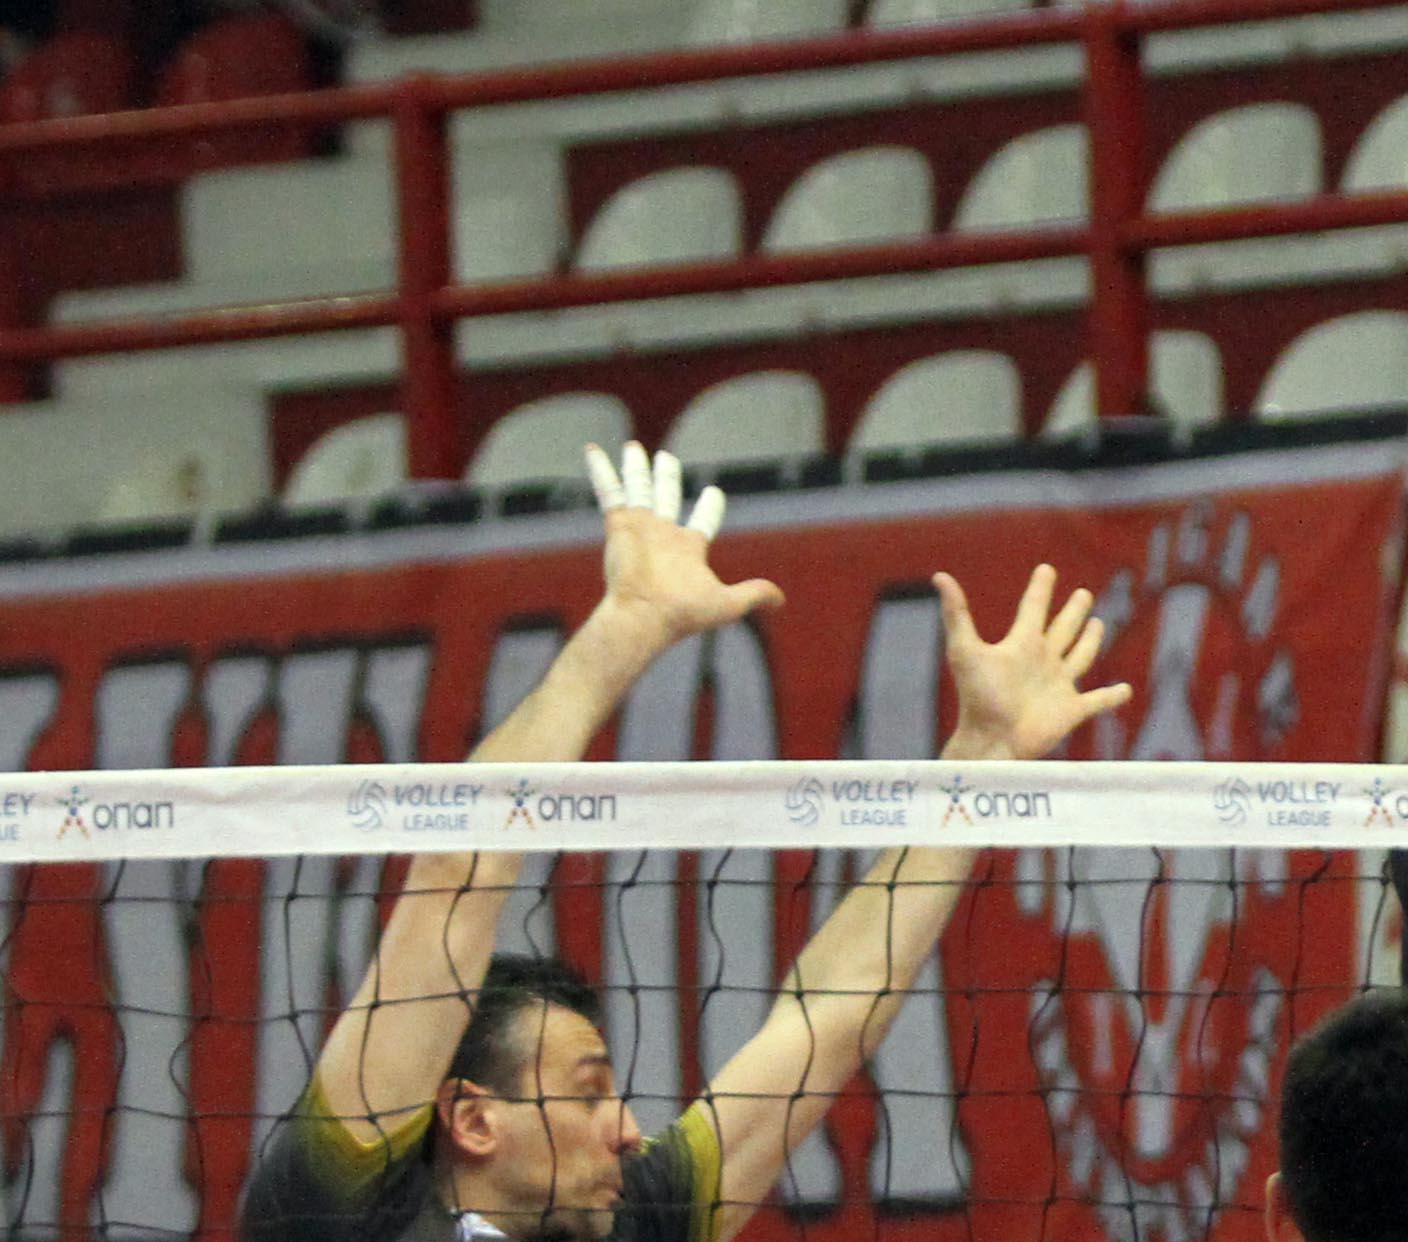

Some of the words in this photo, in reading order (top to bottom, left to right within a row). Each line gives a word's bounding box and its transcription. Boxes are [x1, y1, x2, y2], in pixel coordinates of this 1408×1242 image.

[394, 784, 484, 807] VOLLEY
[832, 779, 918, 802] VOLLEY
[1258, 781, 1342, 804] VOLLEY
[403, 814, 468, 831] LEAGUE
[841, 809, 908, 826] LEAGUE
[1268, 810, 1331, 827] LEAGUE
